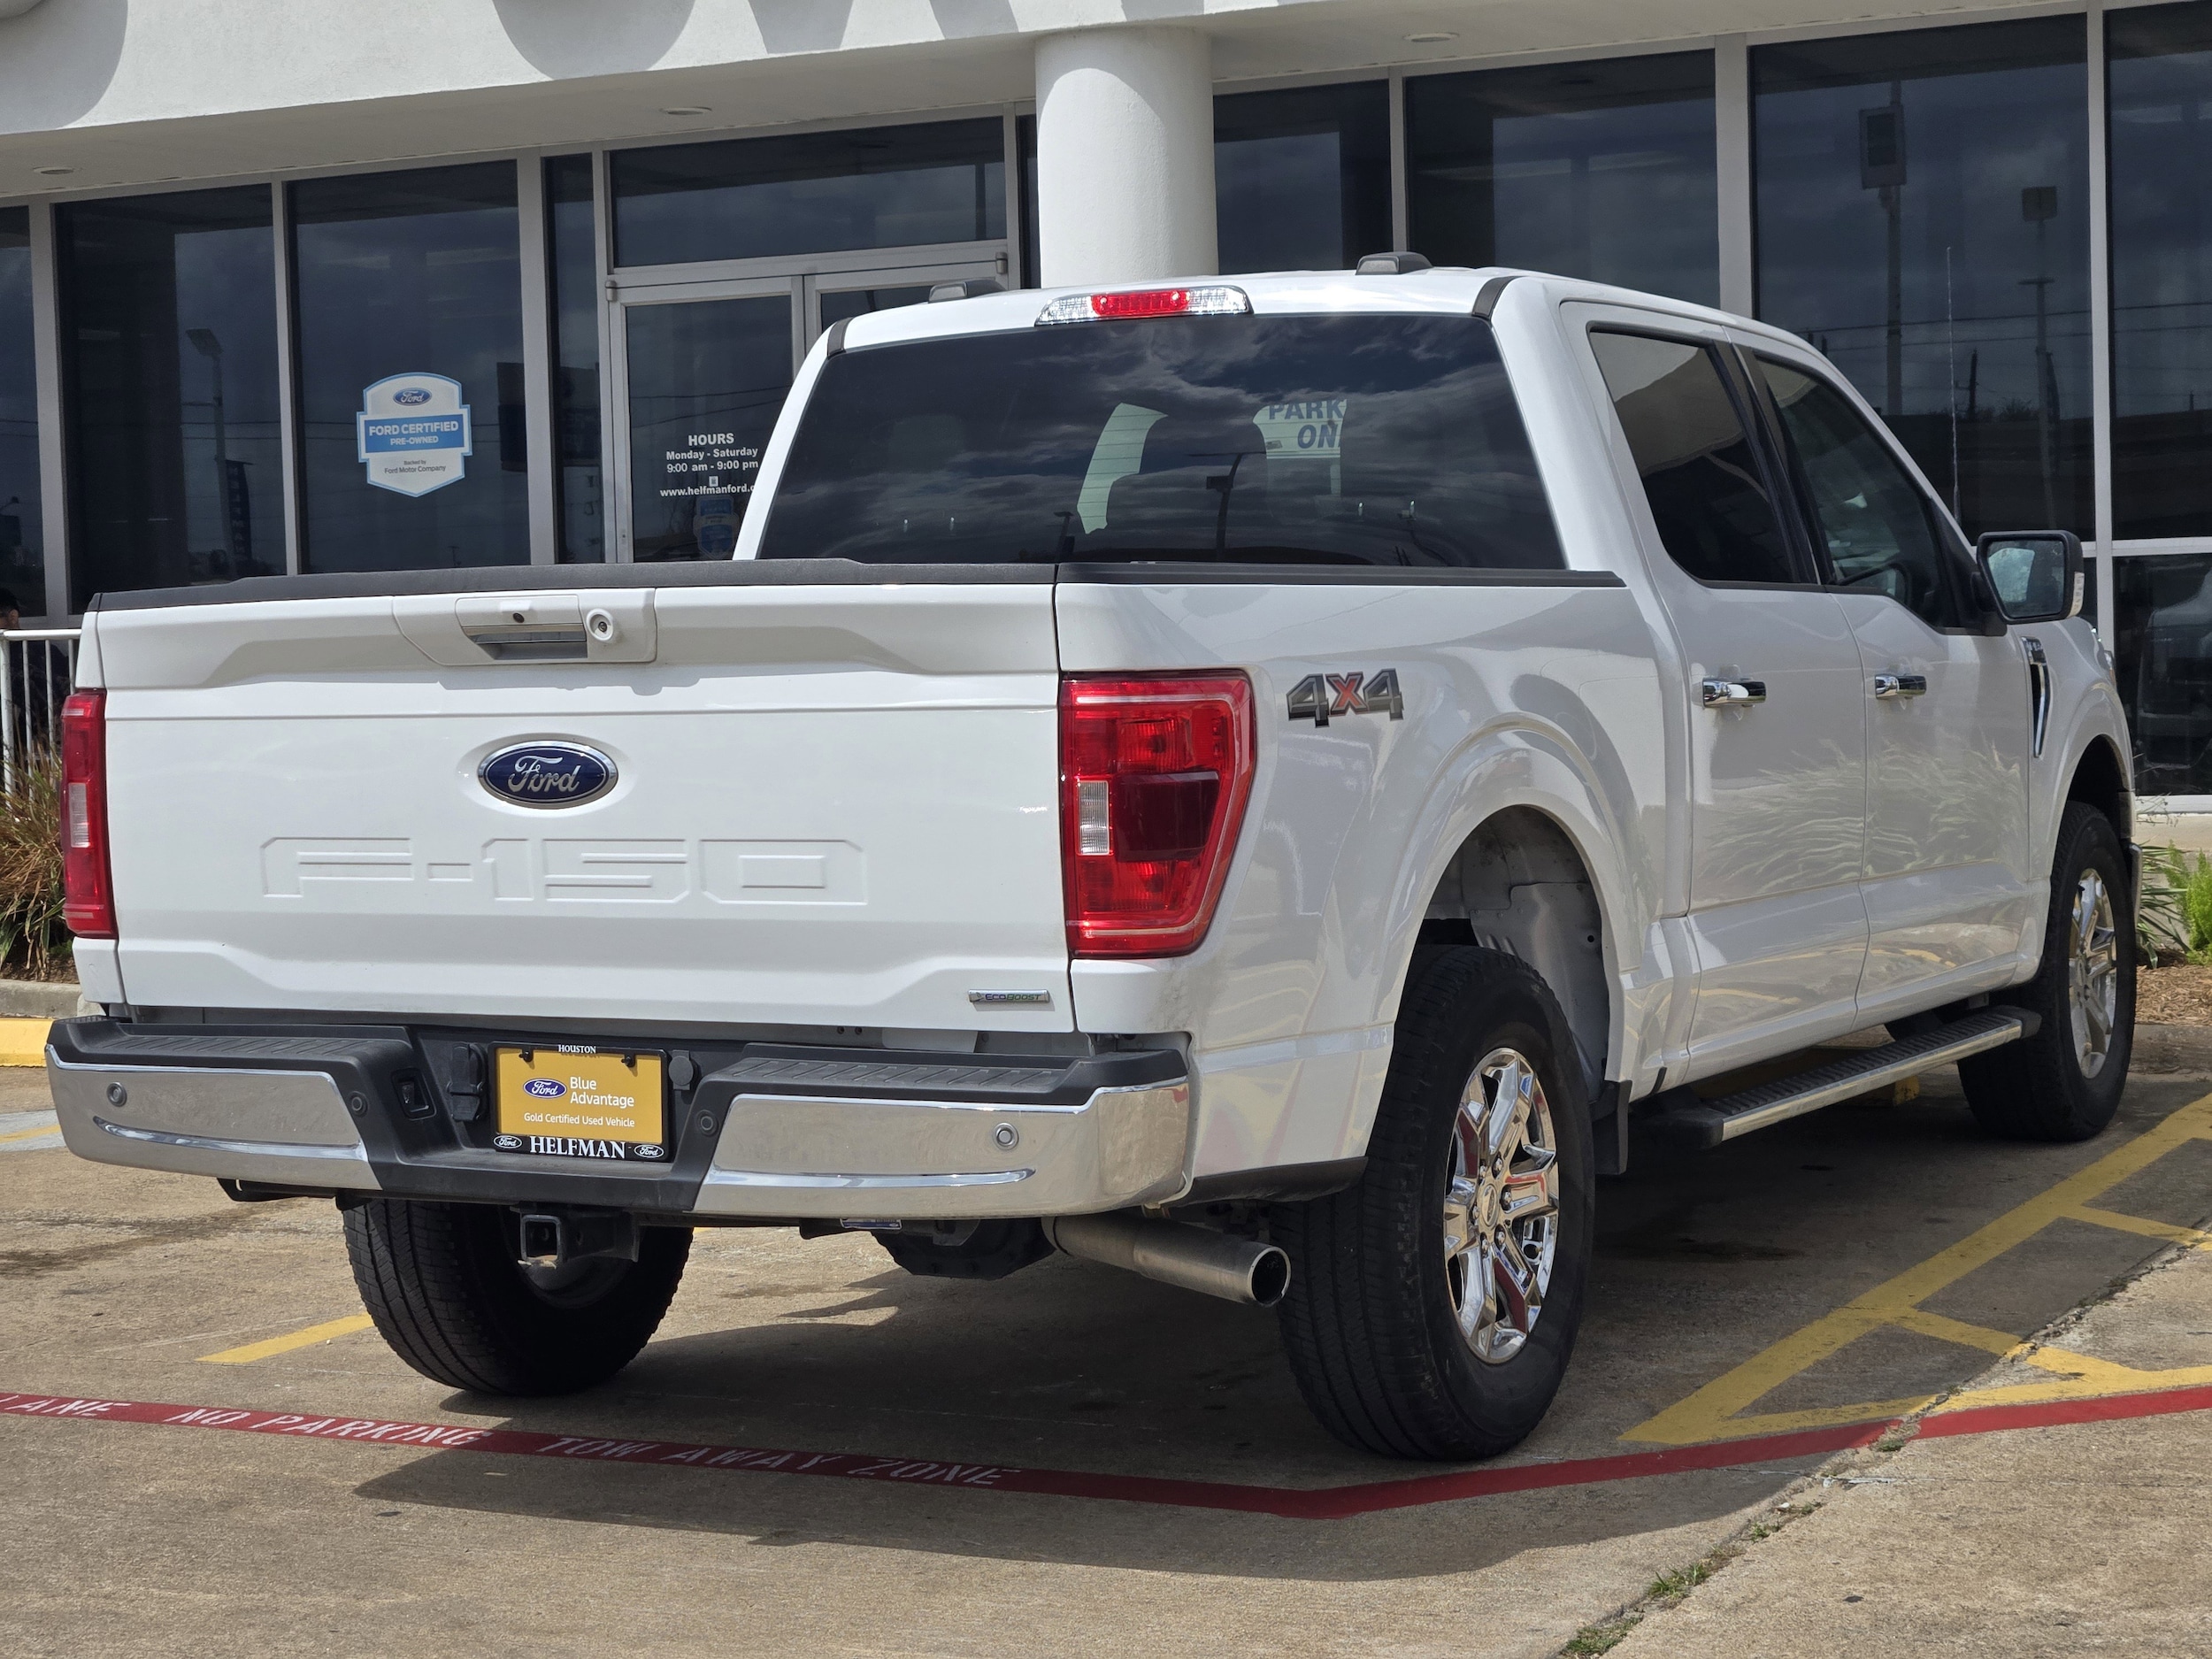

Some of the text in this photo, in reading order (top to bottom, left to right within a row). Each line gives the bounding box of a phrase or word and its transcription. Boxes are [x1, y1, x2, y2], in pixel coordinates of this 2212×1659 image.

[1269, 400, 1343, 419] PARK
[369, 420, 459, 436] FORD CERTIFIED
[1297, 424, 1340, 449] ON
[390, 435, 439, 446] PRE-OWNED
[687, 433, 734, 447] HOURS
[666, 450, 705, 461] Monday
[713, 447, 758, 458] Saturday
[666, 463, 688, 473] 9:00
[717, 460, 740, 471] 9:00
[742, 460, 759, 471] pm
[507, 754, 581, 794] Ford
[261, 836, 869, 906] F-150
[557, 1044, 596, 1054] HOUSTON
[531, 1076, 597, 1096] Ford Blue
[570, 1091, 634, 1110] Advantage
[524, 1112, 635, 1128] Gold Certified Used Vehicle
[529, 1135, 626, 1159] HELFMAN
[165, 1409, 251, 1426] NO
[250, 1416, 493, 1447] PARKING
[535, 1437, 660, 1459] TOW
[660, 1447, 846, 1472] AWAY
[847, 1457, 1022, 1486] ZONE
